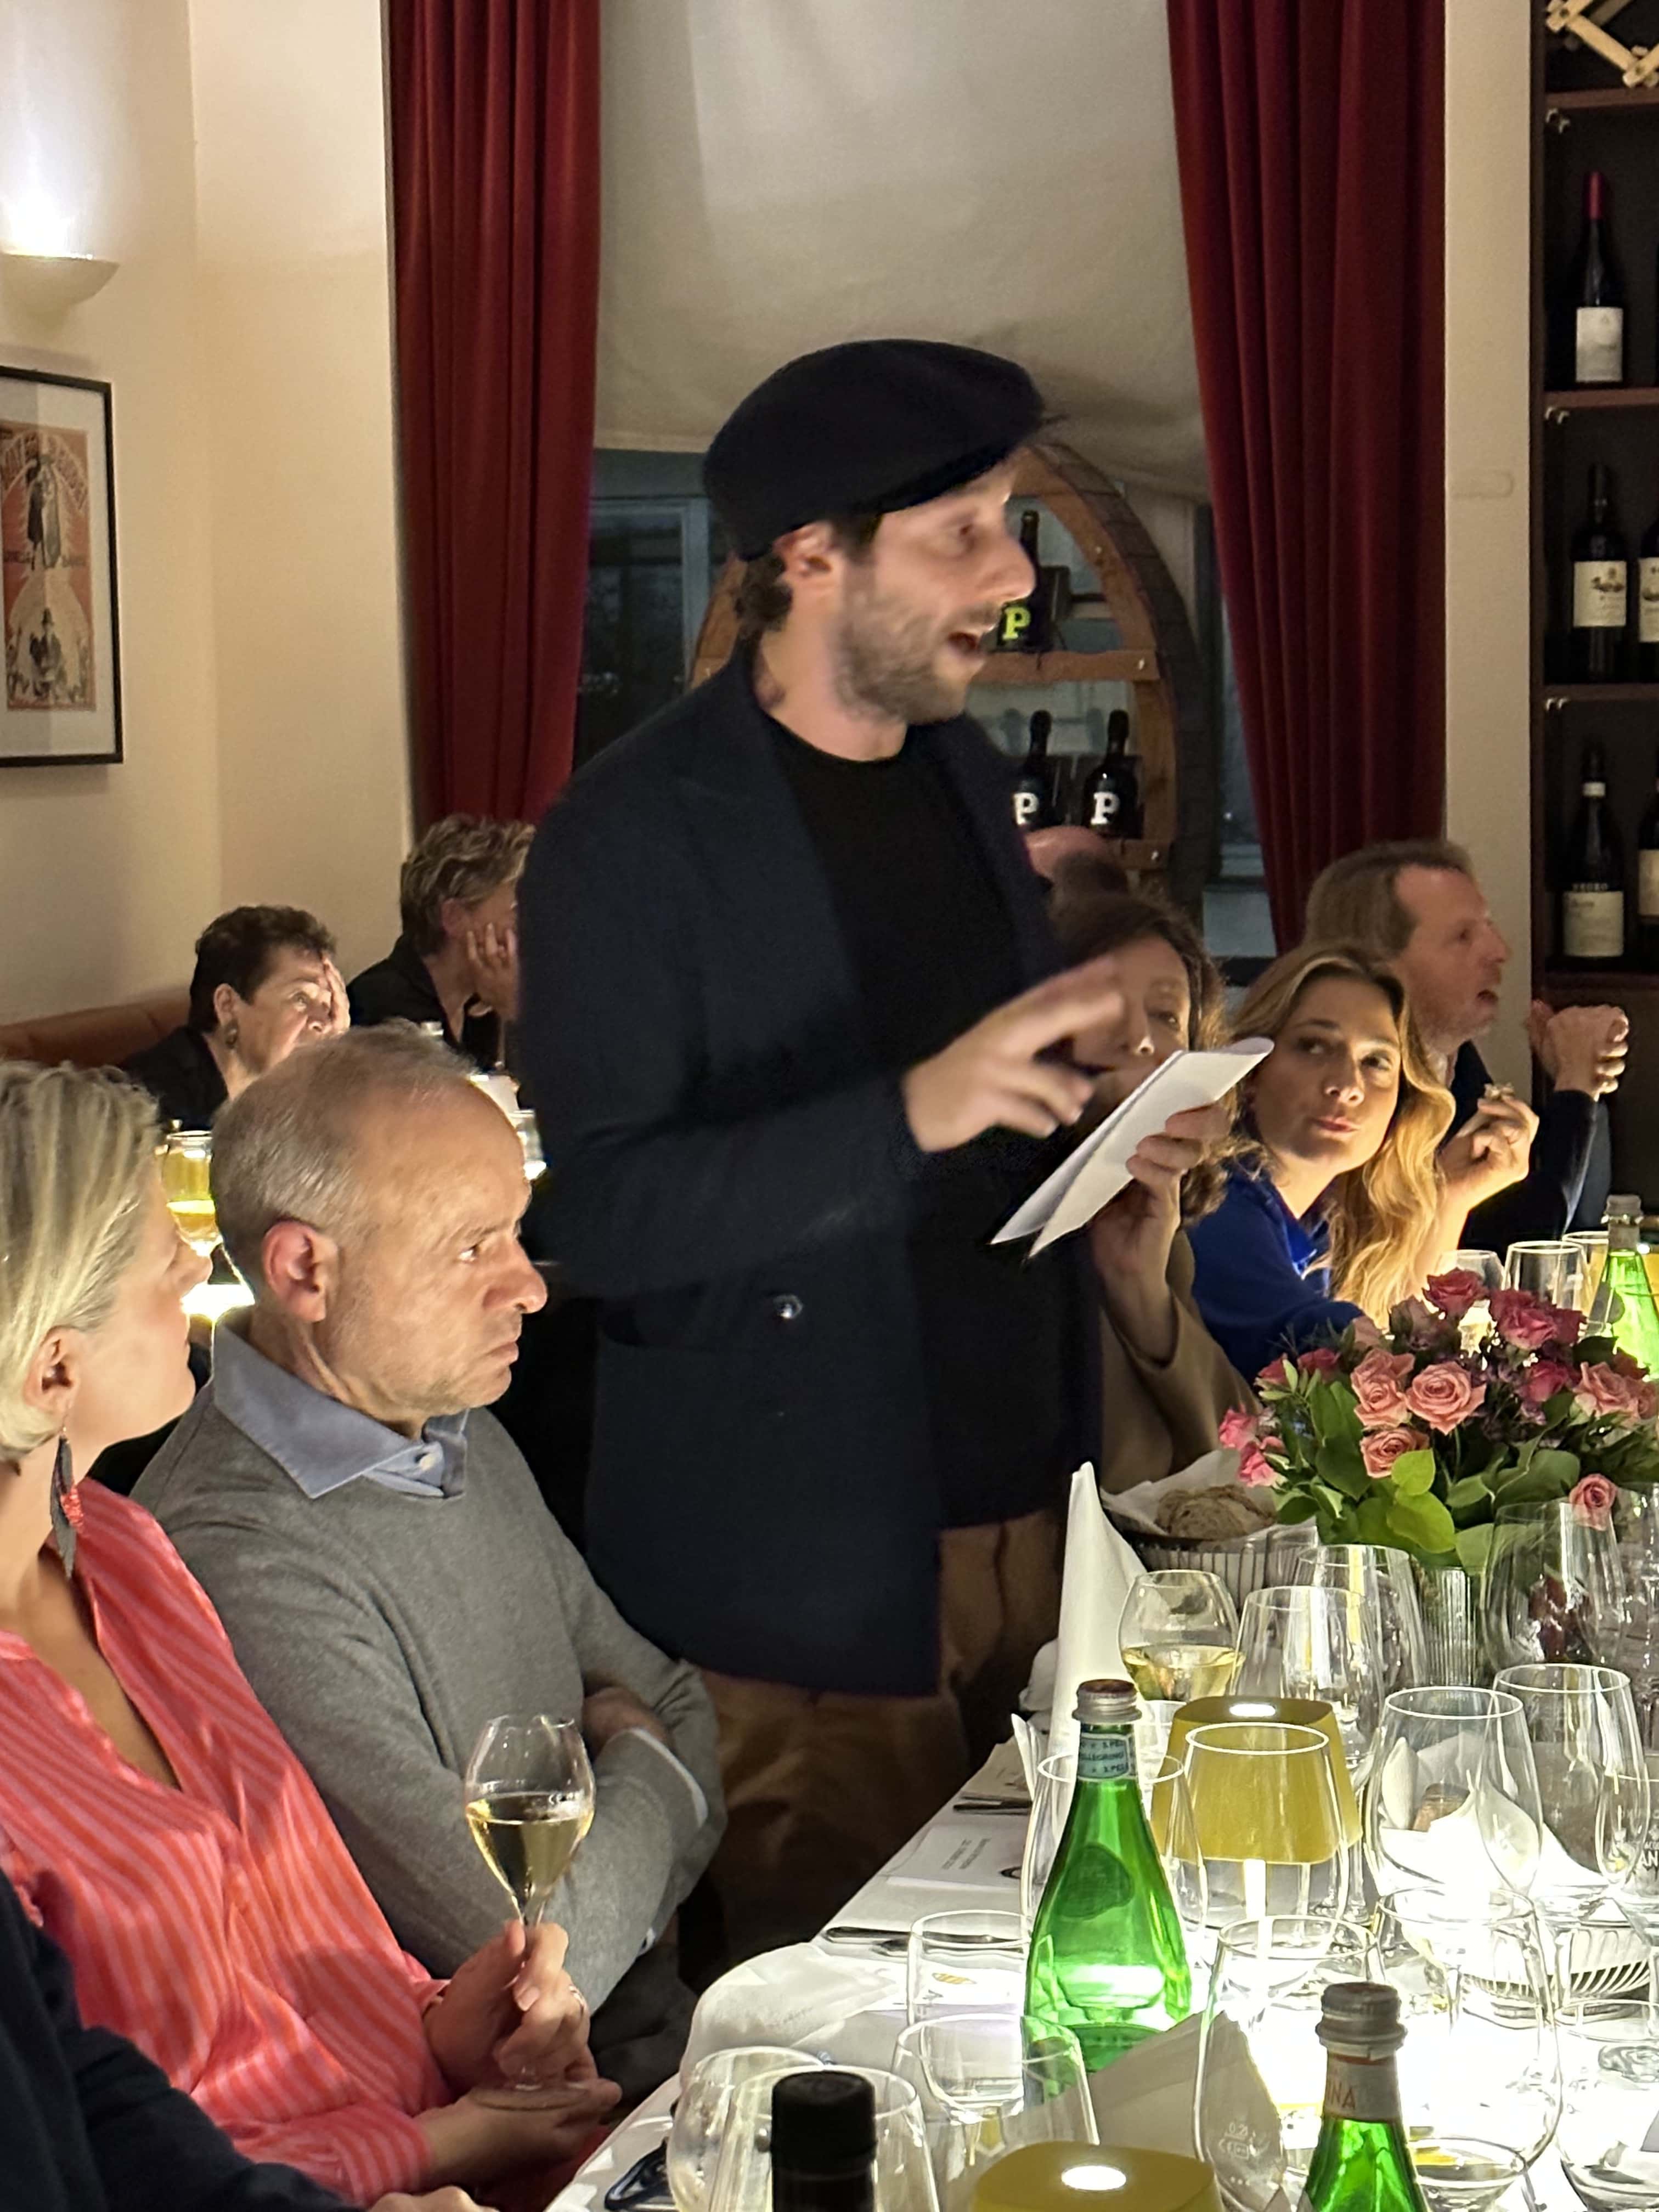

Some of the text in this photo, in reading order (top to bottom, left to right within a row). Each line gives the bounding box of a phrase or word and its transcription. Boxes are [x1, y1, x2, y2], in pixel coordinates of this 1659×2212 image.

[1002, 606, 1031, 640] P
[1013, 792, 1040, 825] P
[1090, 791, 1120, 825] P
